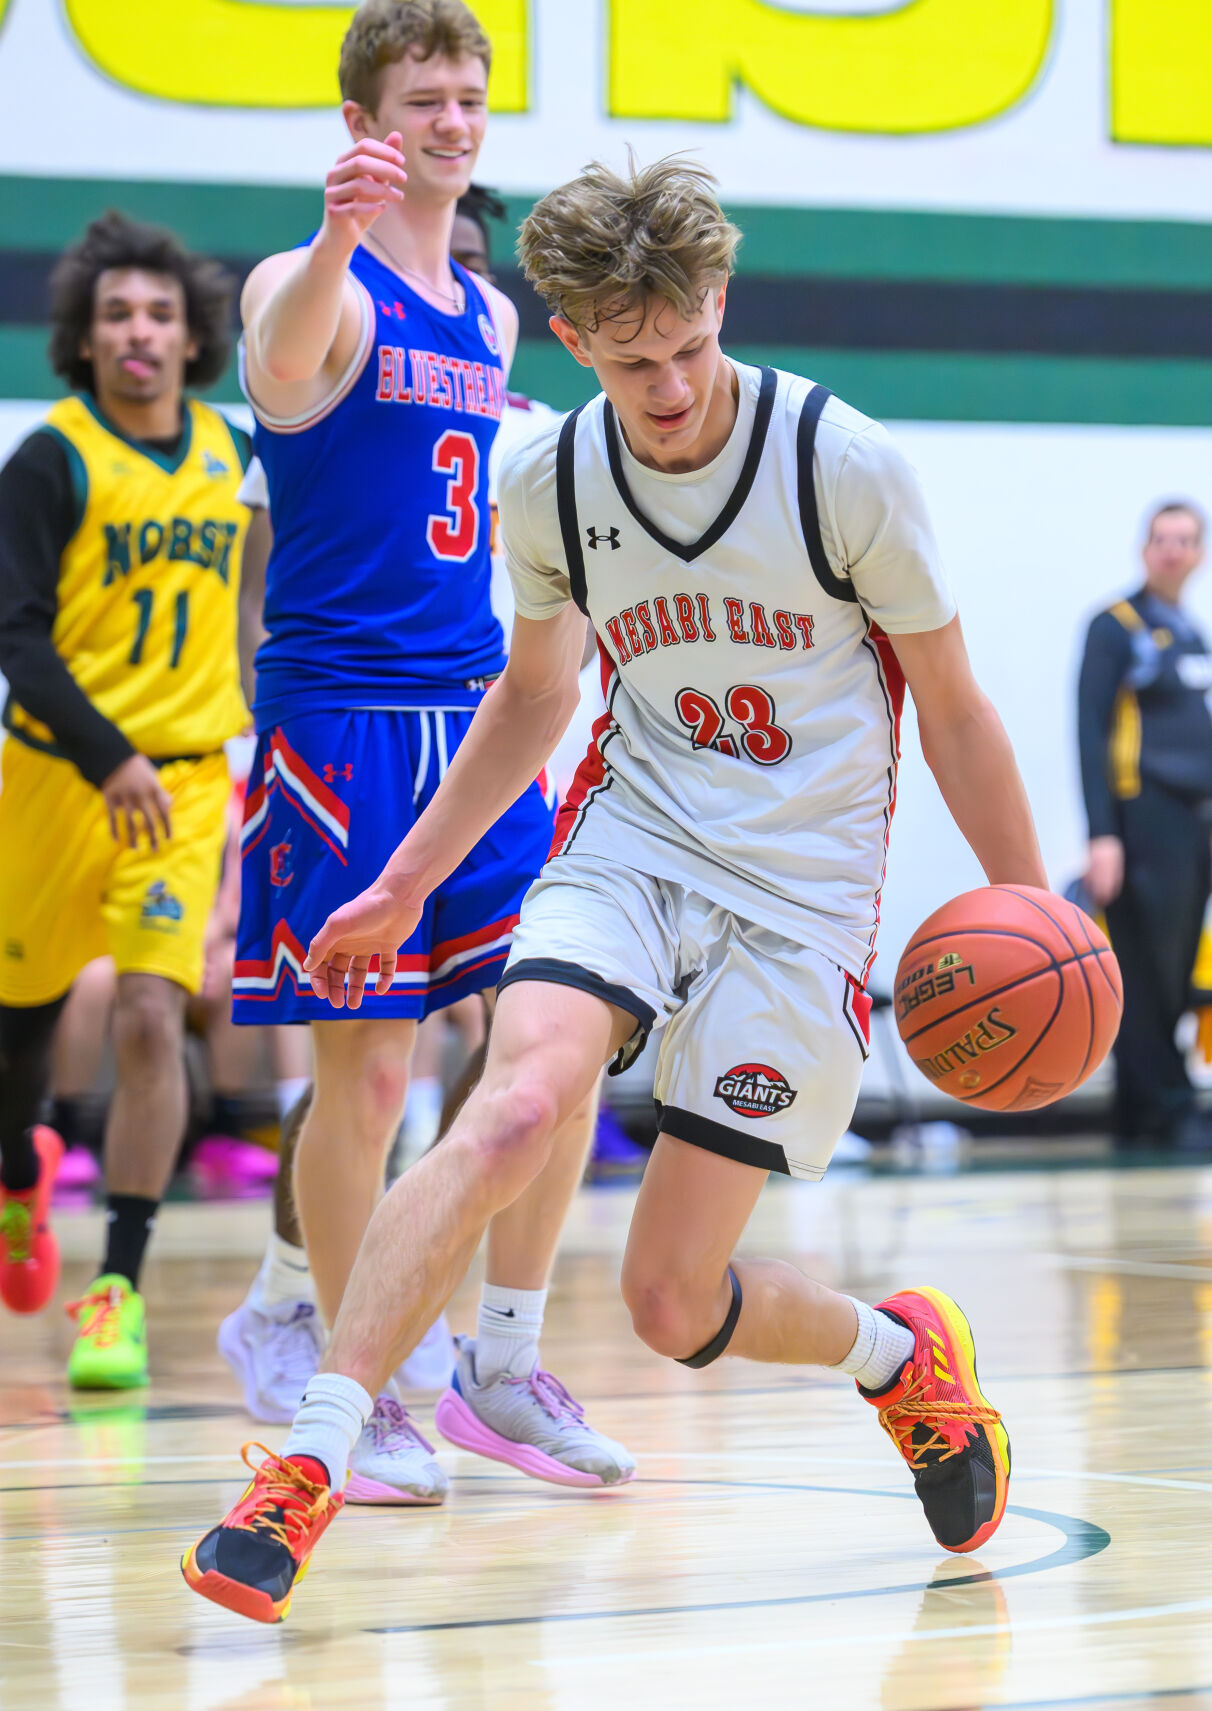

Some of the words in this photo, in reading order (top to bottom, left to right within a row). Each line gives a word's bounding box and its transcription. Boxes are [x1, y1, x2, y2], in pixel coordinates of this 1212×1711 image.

[426, 429, 480, 562] 3
[129, 588, 188, 669] 11
[605, 593, 716, 666] MESABI
[723, 597, 815, 650] EAST
[675, 684, 792, 766] 23
[718, 1079, 793, 1106] GIANTS
[732, 1099, 760, 1110] MESABI
[760, 1104, 776, 1113] EAST
